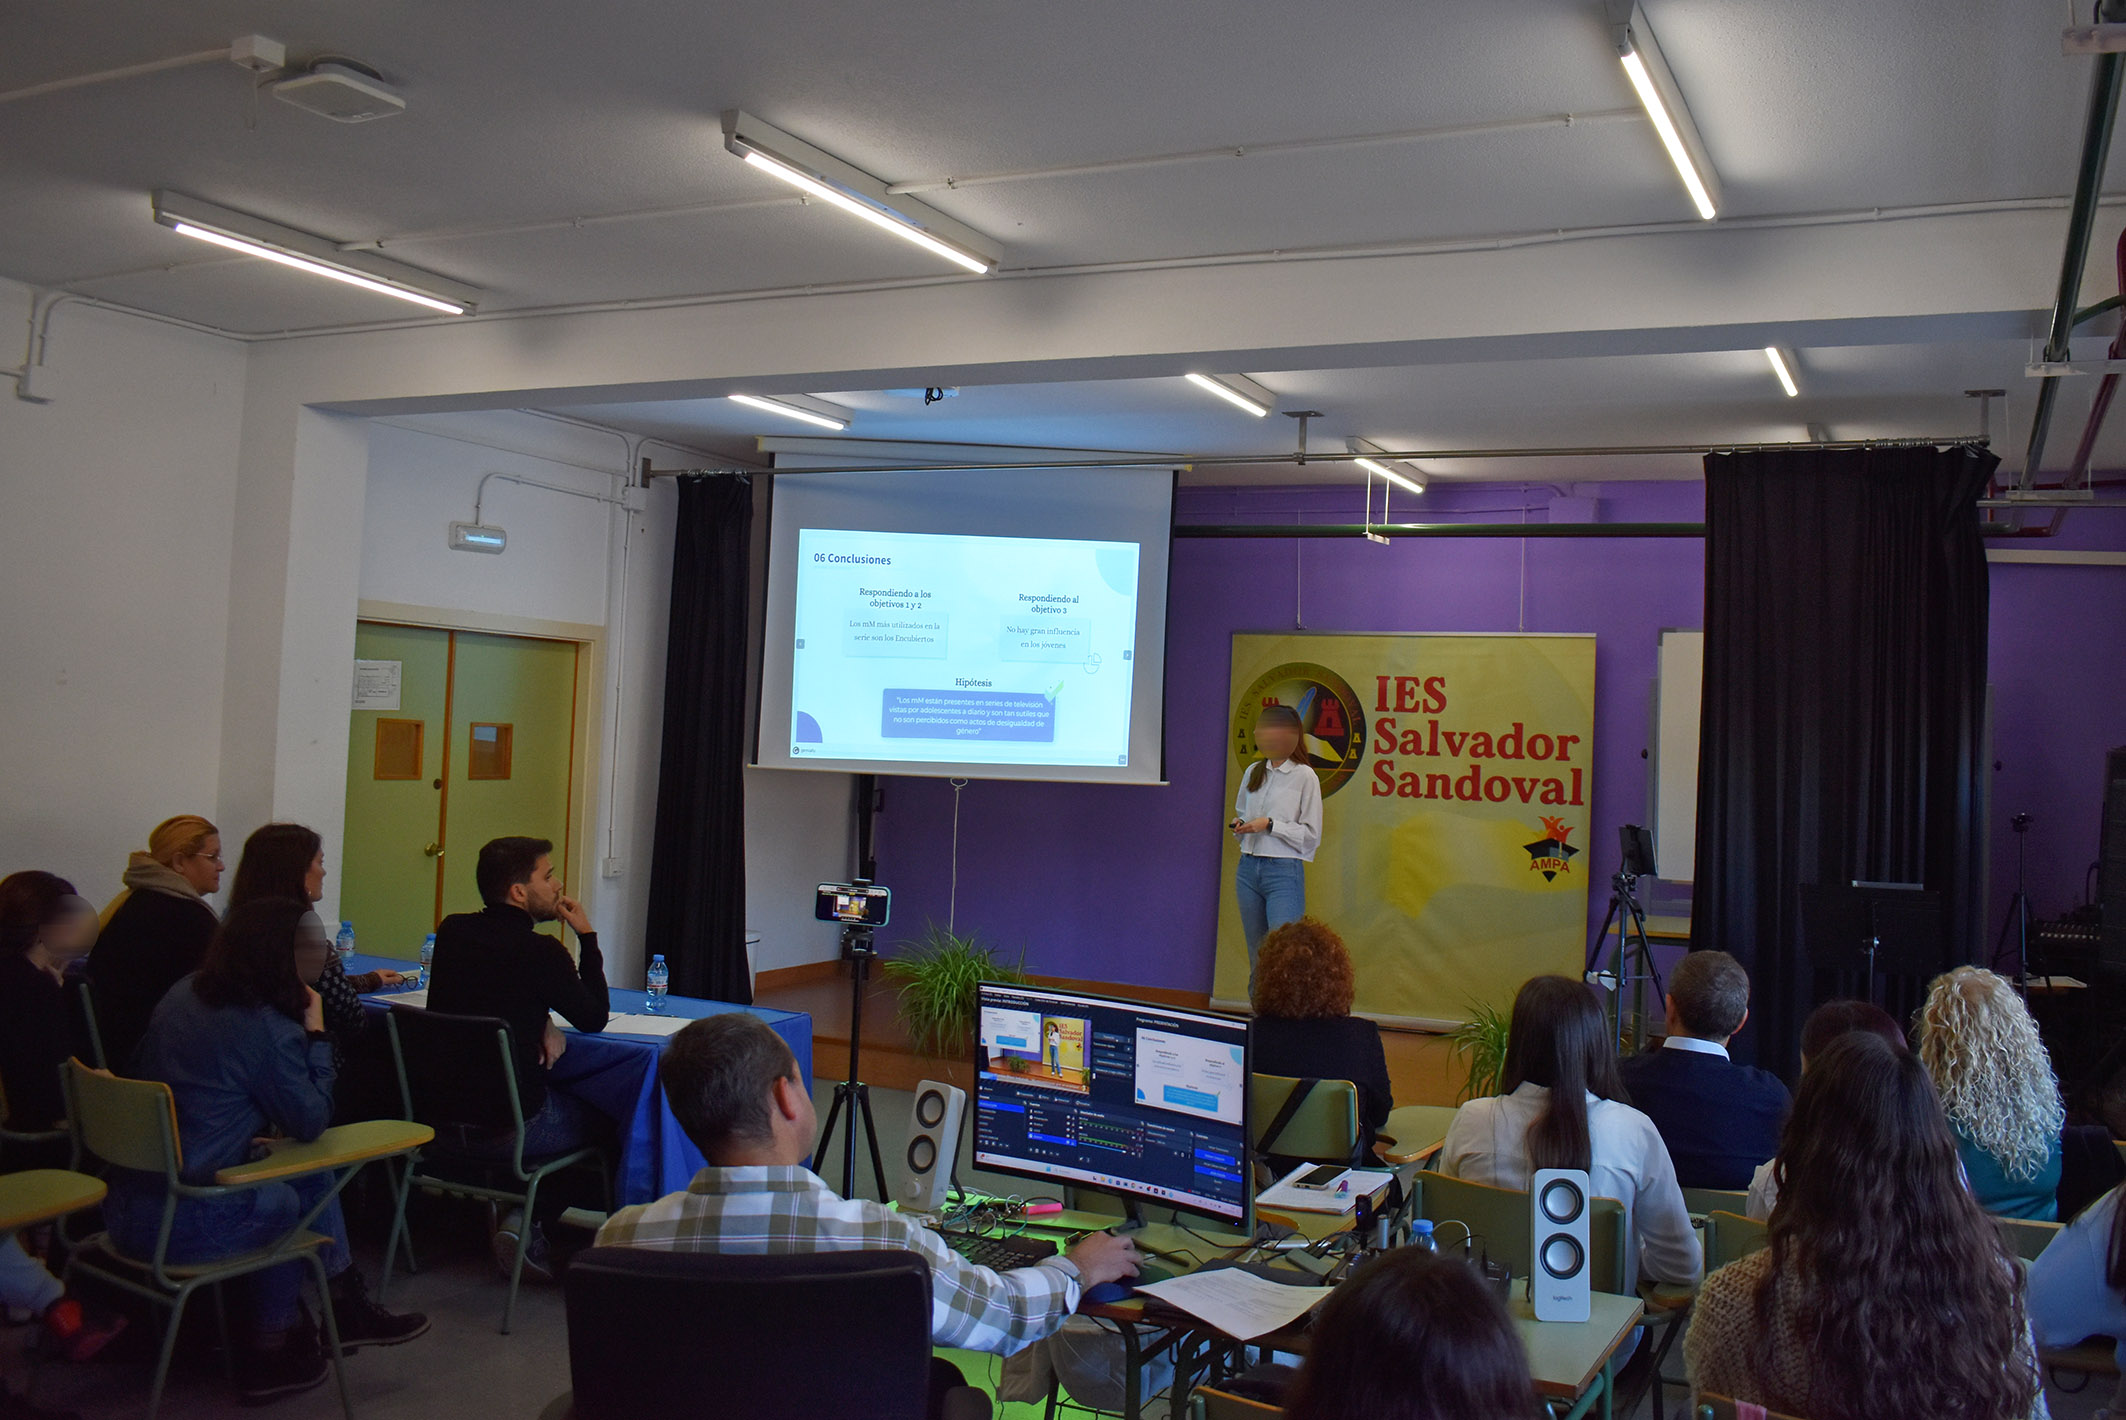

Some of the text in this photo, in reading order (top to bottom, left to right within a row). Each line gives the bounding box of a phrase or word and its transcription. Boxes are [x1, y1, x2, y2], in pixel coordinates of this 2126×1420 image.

[814, 553, 892, 565] 06 Conclusiones
[860, 588, 913, 598] Respondiendo
[920, 590, 932, 598] los
[1018, 593, 1079, 604] Respondiendo al
[870, 599, 904, 609] objetivos
[910, 602, 916, 610] y
[1031, 605, 1062, 614] objetivo
[892, 621, 923, 629] utilizados
[934, 622, 940, 630] la
[1017, 626, 1029, 635] hay
[1047, 628, 1080, 636] influencia
[884, 634, 894, 642] los
[895, 634, 934, 642] Encubiertos
[1041, 641, 1066, 649] jóvenes
[955, 678, 992, 688] Hipótesis
[1375, 675, 1447, 714] IES
[996, 720, 1035, 728] desigualdad
[1374, 717, 1581, 761] Salvador
[1371, 759, 1584, 806] Sandoval
[1530, 858, 1570, 874] AMPA
